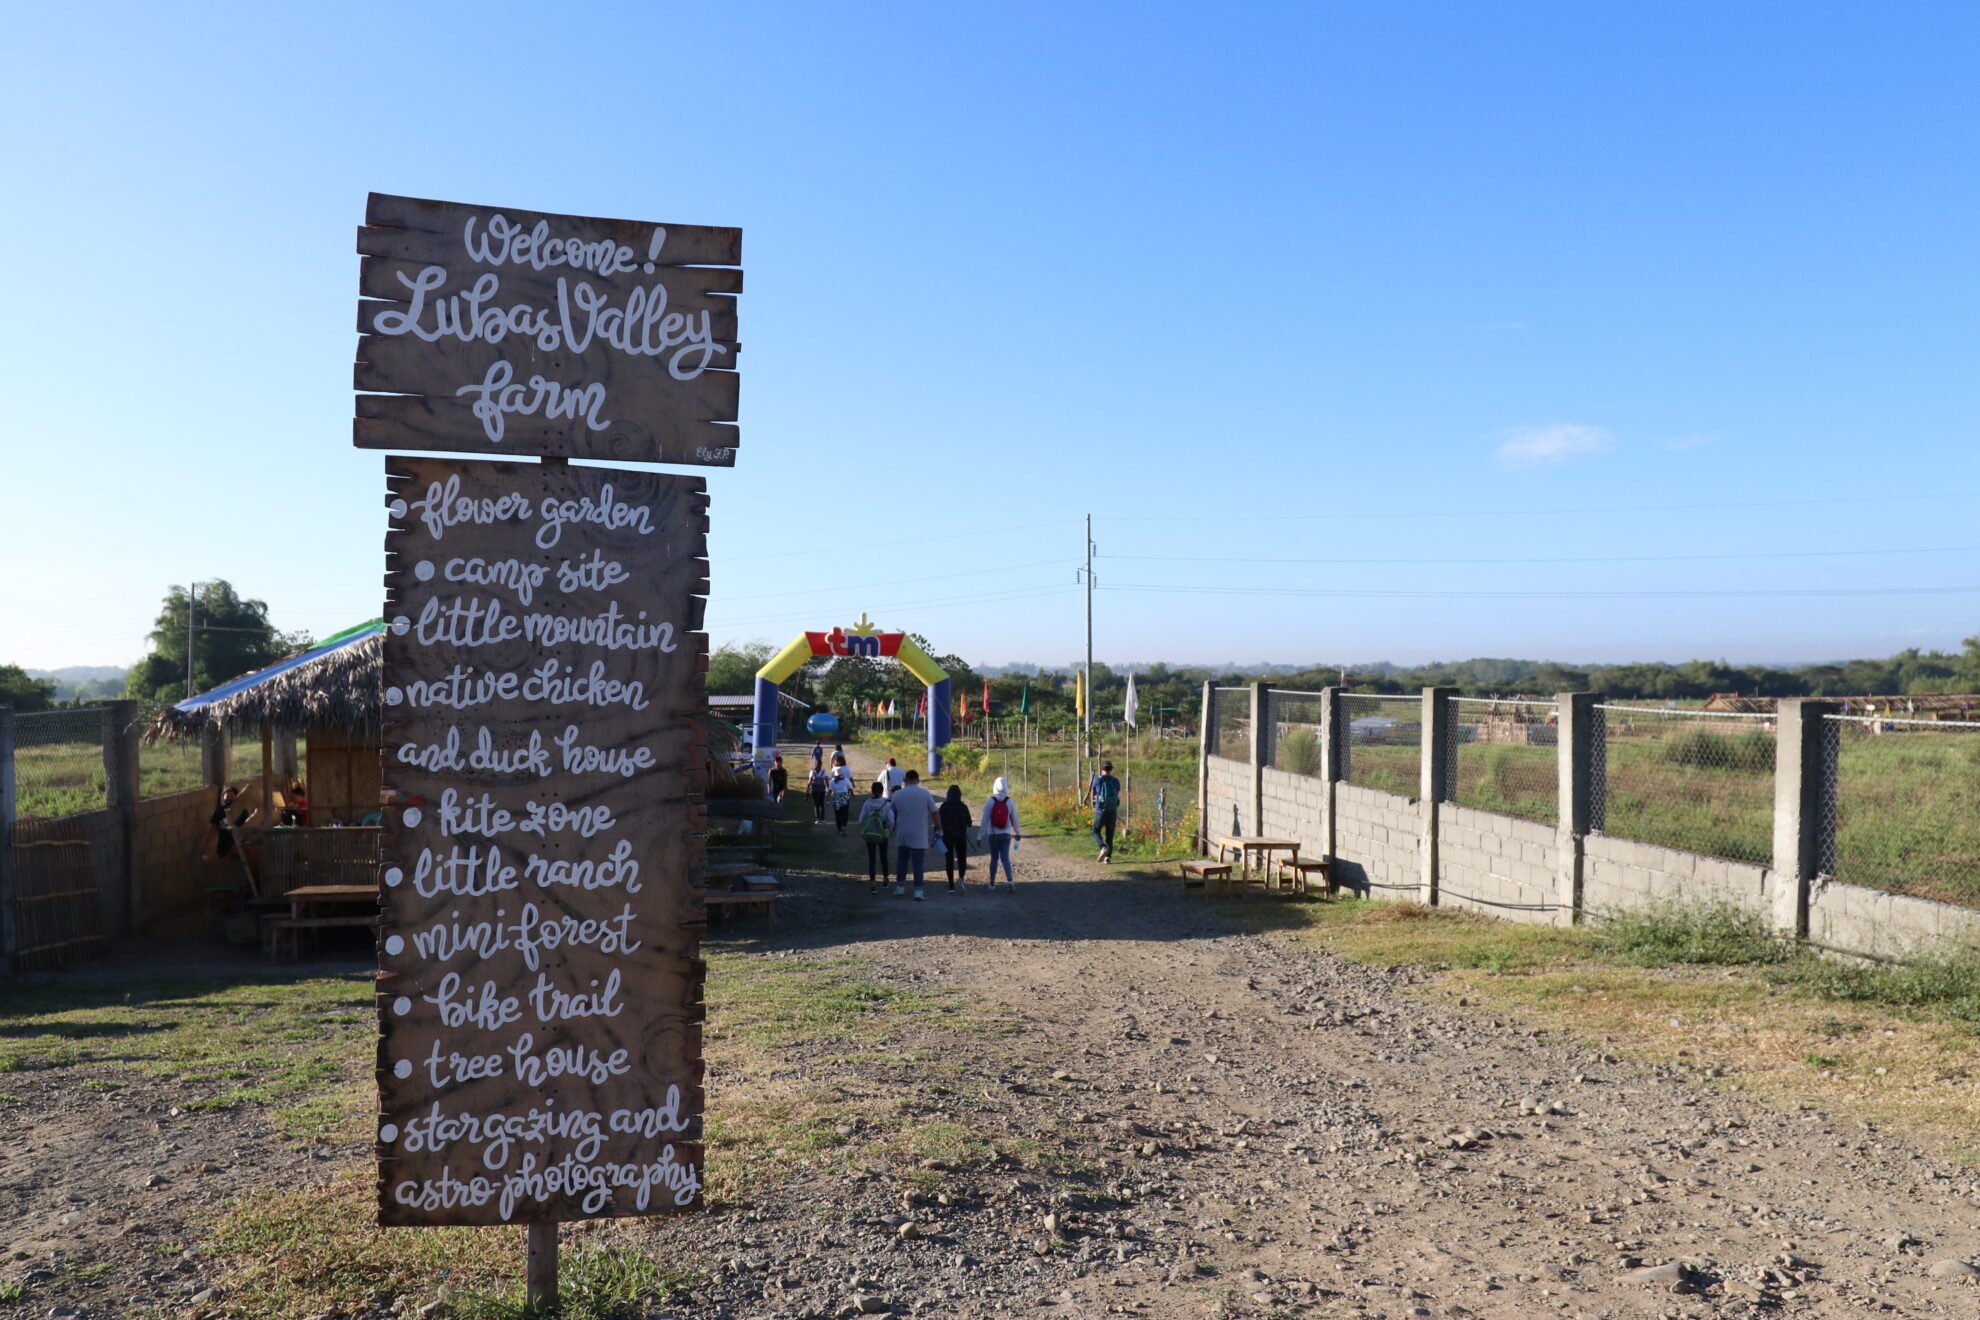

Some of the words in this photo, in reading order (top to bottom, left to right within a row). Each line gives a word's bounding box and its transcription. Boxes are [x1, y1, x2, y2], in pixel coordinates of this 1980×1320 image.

[464, 213, 667, 276] Welcome!
[456, 360, 611, 442] farm
[410, 474, 533, 540] flower
[535, 483, 656, 549] garden
[444, 557, 551, 606] camp
[557, 548, 630, 593] site
[413, 596, 522, 647] little
[523, 600, 678, 653] mountain
[825, 626, 881, 657] tm
[406, 664, 520, 709] native
[522, 658, 650, 710] chicken
[397, 725, 466, 772] and
[469, 725, 553, 777] duck
[554, 724, 657, 777] house
[437, 787, 516, 837] kite
[519, 801, 617, 837] zone
[413, 845, 520, 898] little
[524, 839, 643, 893] ranch
[413, 909, 509, 961] mini
[508, 902, 642, 971] forest
[423, 972, 523, 1031] bike
[528, 967, 625, 1022] trail
[423, 1039, 504, 1088] tree
[507, 1032, 632, 1087] house
[403, 1098, 610, 1170] stargazing
[609, 1084, 691, 1139] and
[394, 1143, 703, 1220] astro-photography
